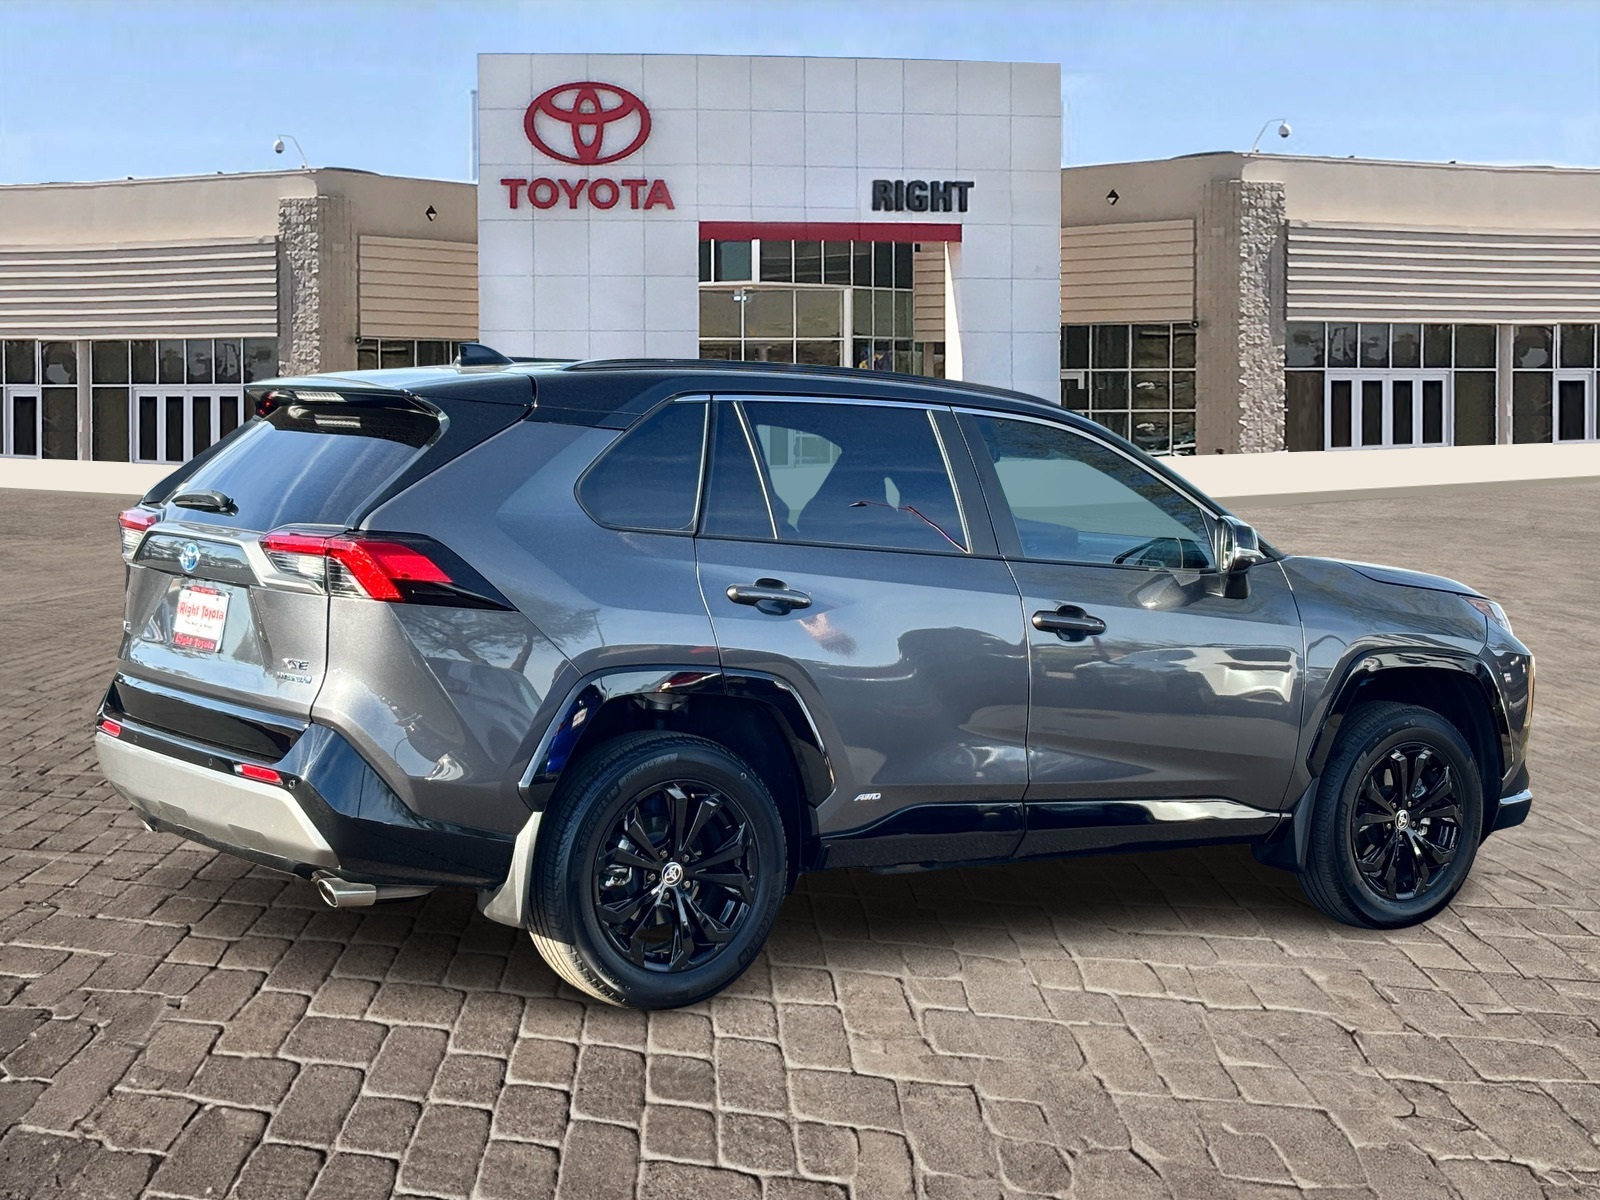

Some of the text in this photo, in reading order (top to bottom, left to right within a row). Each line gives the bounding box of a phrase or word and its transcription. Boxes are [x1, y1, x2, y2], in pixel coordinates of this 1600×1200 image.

[500, 177, 675, 210] TOYOTA
[871, 179, 975, 212] RIGHT
[179, 602, 224, 621] Right Toyota
[853, 792, 882, 802] AWD
